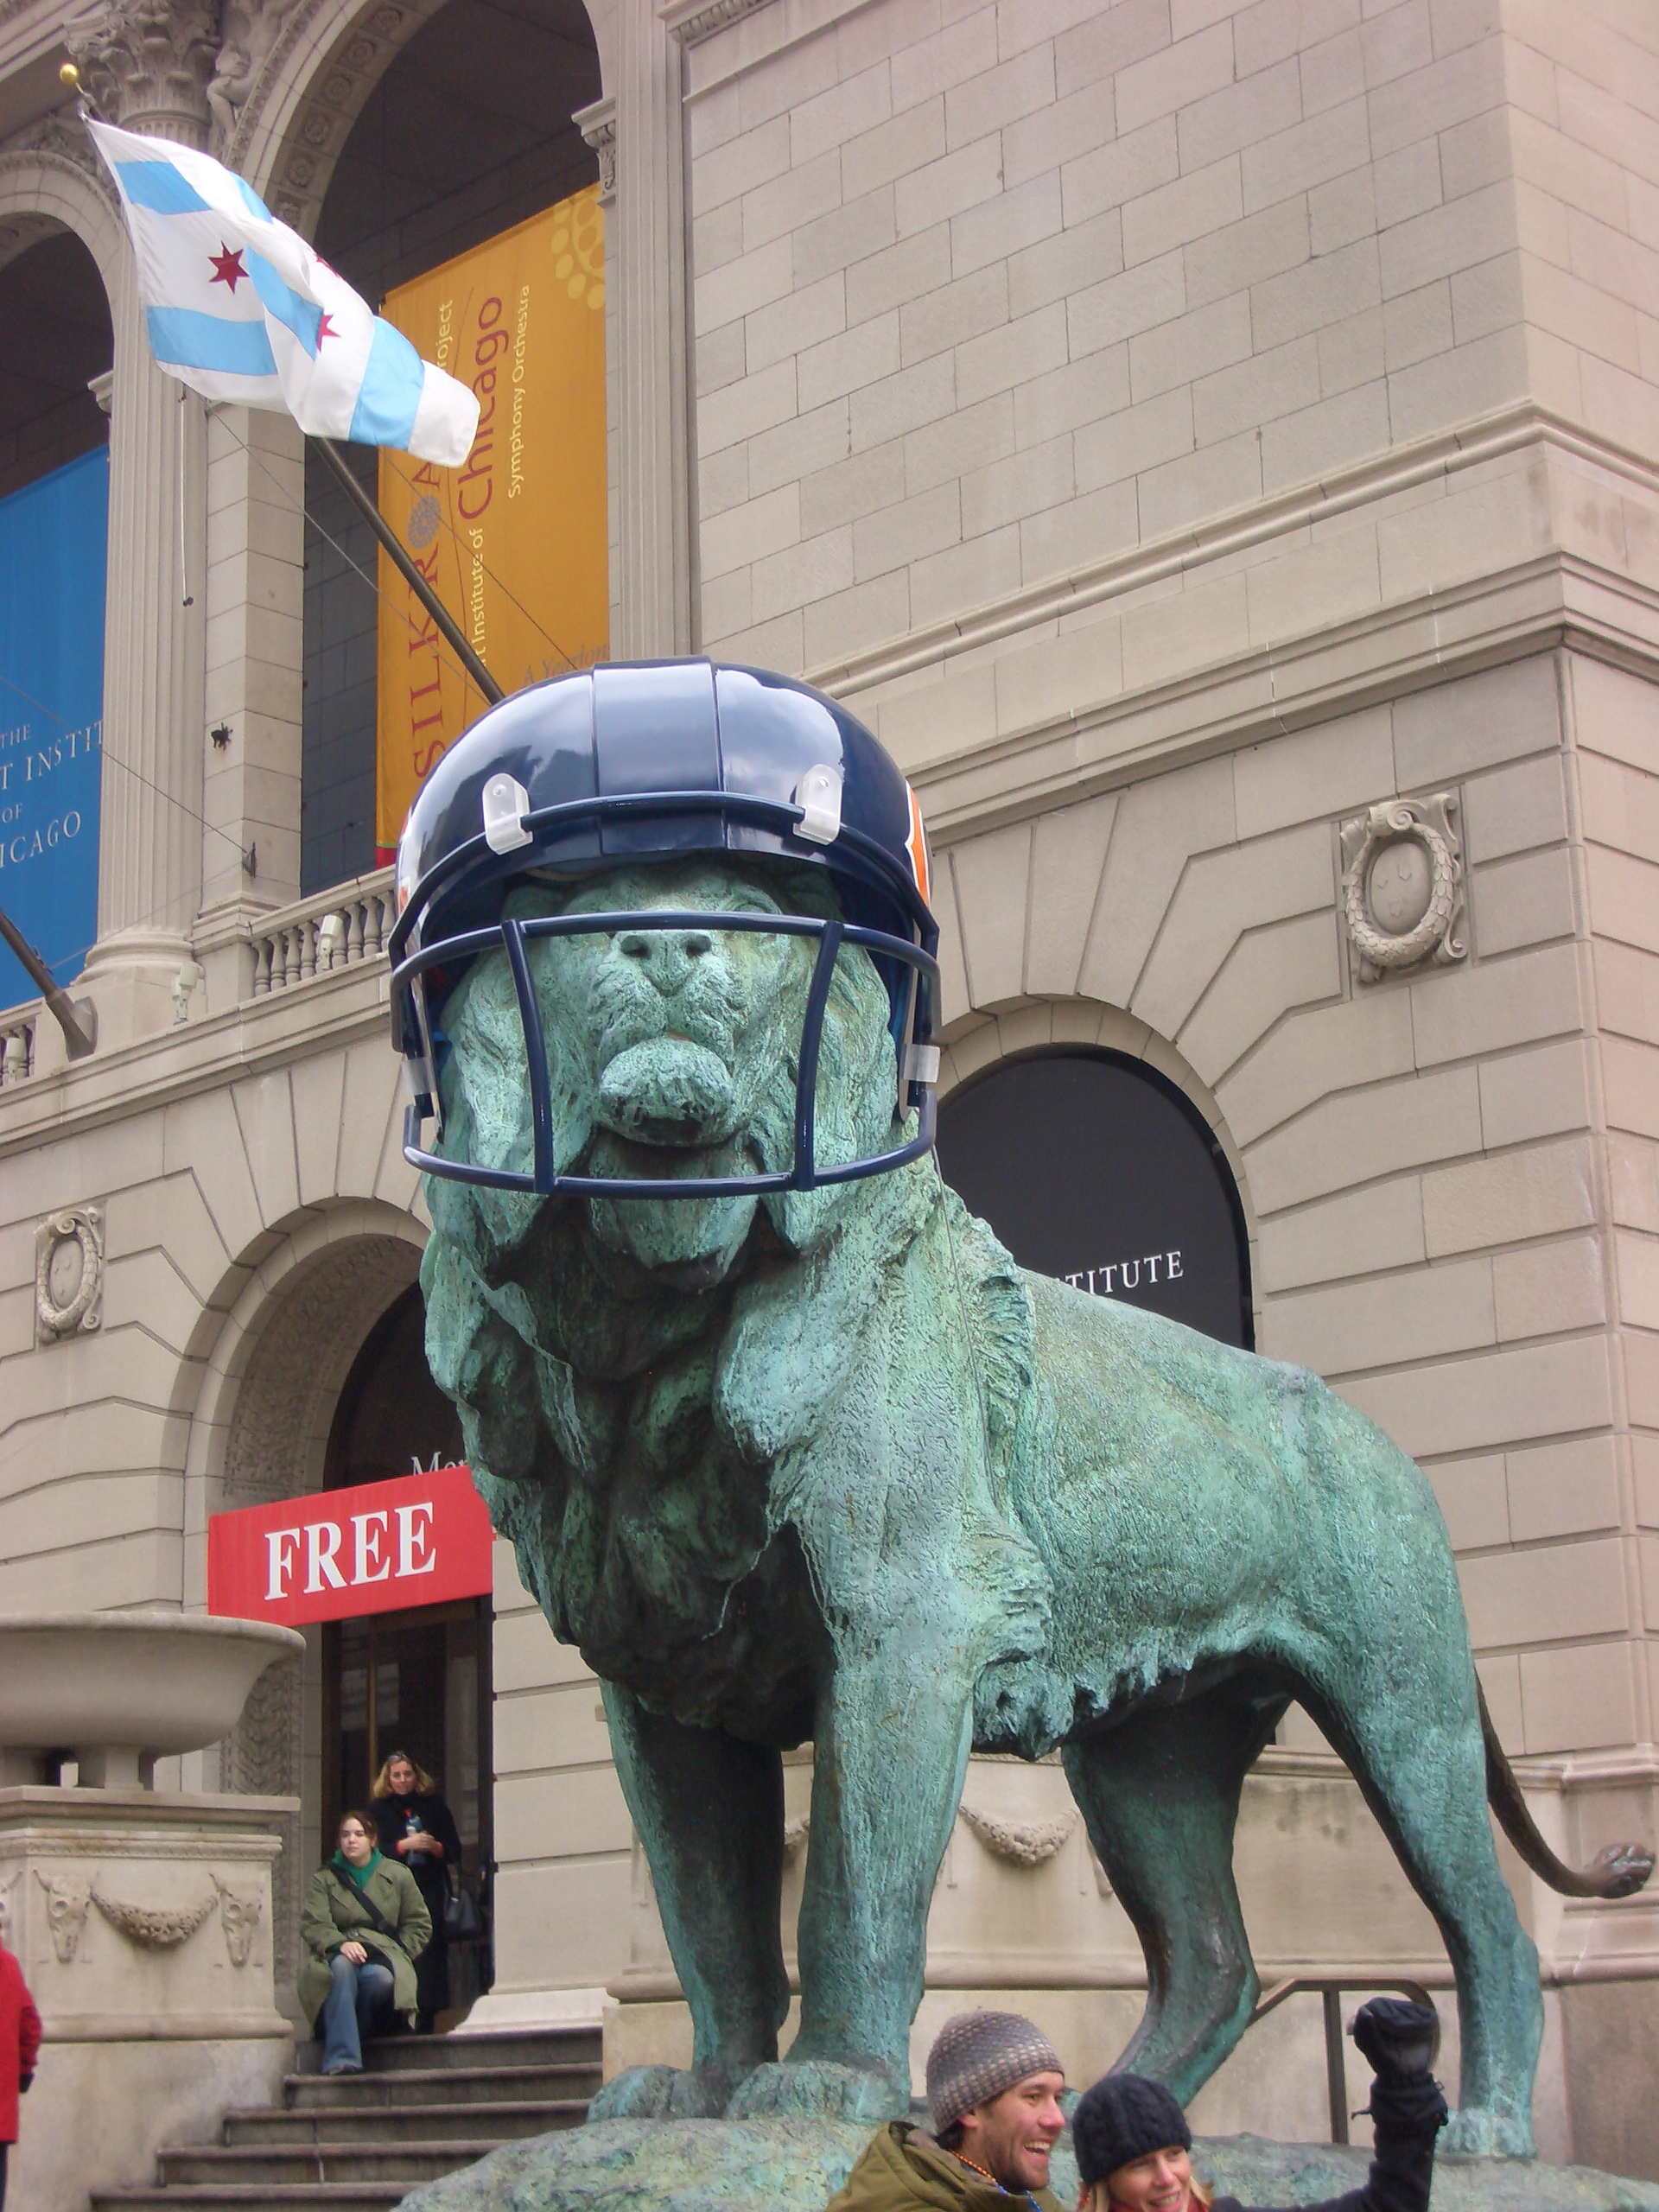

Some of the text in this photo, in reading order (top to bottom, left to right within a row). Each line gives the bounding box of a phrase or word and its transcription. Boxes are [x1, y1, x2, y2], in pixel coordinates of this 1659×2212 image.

[435, 299, 453, 372] roject
[457, 296, 510, 520] Chicago
[508, 284, 531, 499] Symphony Orchestra
[468, 527, 484, 549] of
[470, 553, 486, 645] Institute
[407, 609, 447, 778] SILK
[0, 724, 30, 749] THE
[2, 803, 22, 823] OF
[1056, 1250, 1184, 1295] TITUTE
[264, 1502, 437, 1601] FREE
